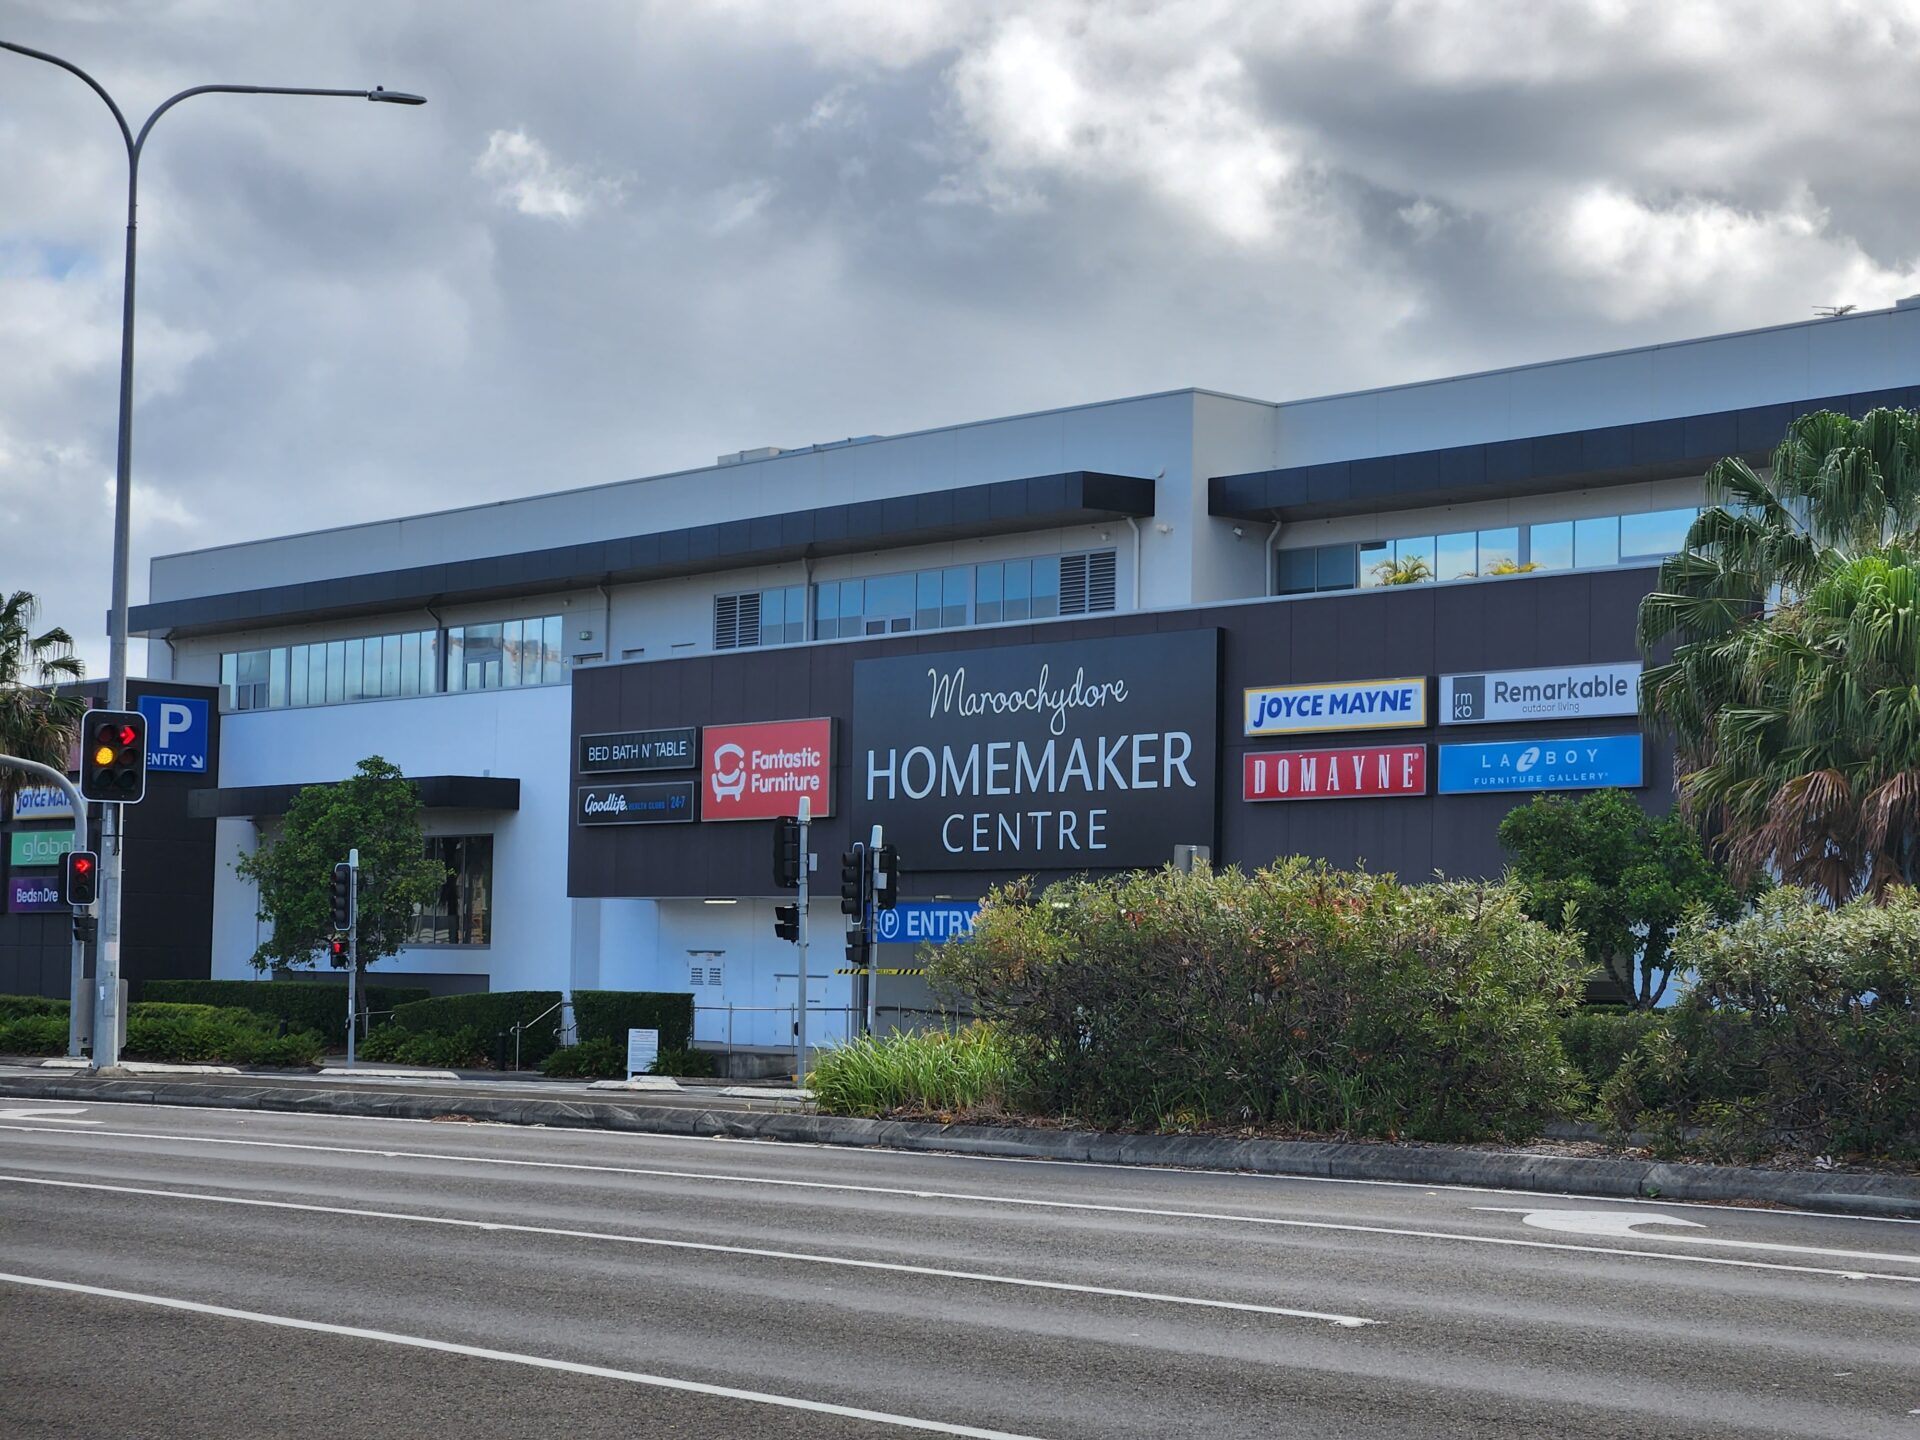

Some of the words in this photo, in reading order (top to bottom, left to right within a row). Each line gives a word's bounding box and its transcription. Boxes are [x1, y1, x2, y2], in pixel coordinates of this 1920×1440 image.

[927, 663, 1128, 736] Maroochydore
[1328, 688, 1413, 715] MAYNE
[1494, 673, 1628, 703] Remarkable
[1522, 703, 1555, 713] outdoor
[1557, 701, 1580, 713] living
[159, 703, 192, 749] P
[588, 746, 609, 761] BED
[612, 744, 638, 760] BATH
[654, 741, 687, 757] TABLE
[752, 747, 820, 770] Fantastic
[866, 731, 1197, 801] HOMEMAKER
[1474, 775, 1542, 785] FURNITURE
[1549, 772, 1606, 782] GALLERY
[751, 772, 820, 793] Furniture
[942, 809, 1107, 853] CENTRE
[23, 833, 75, 861] global
[16, 888, 59, 903] BedsnDre
[907, 910, 977, 937] ENTRY
